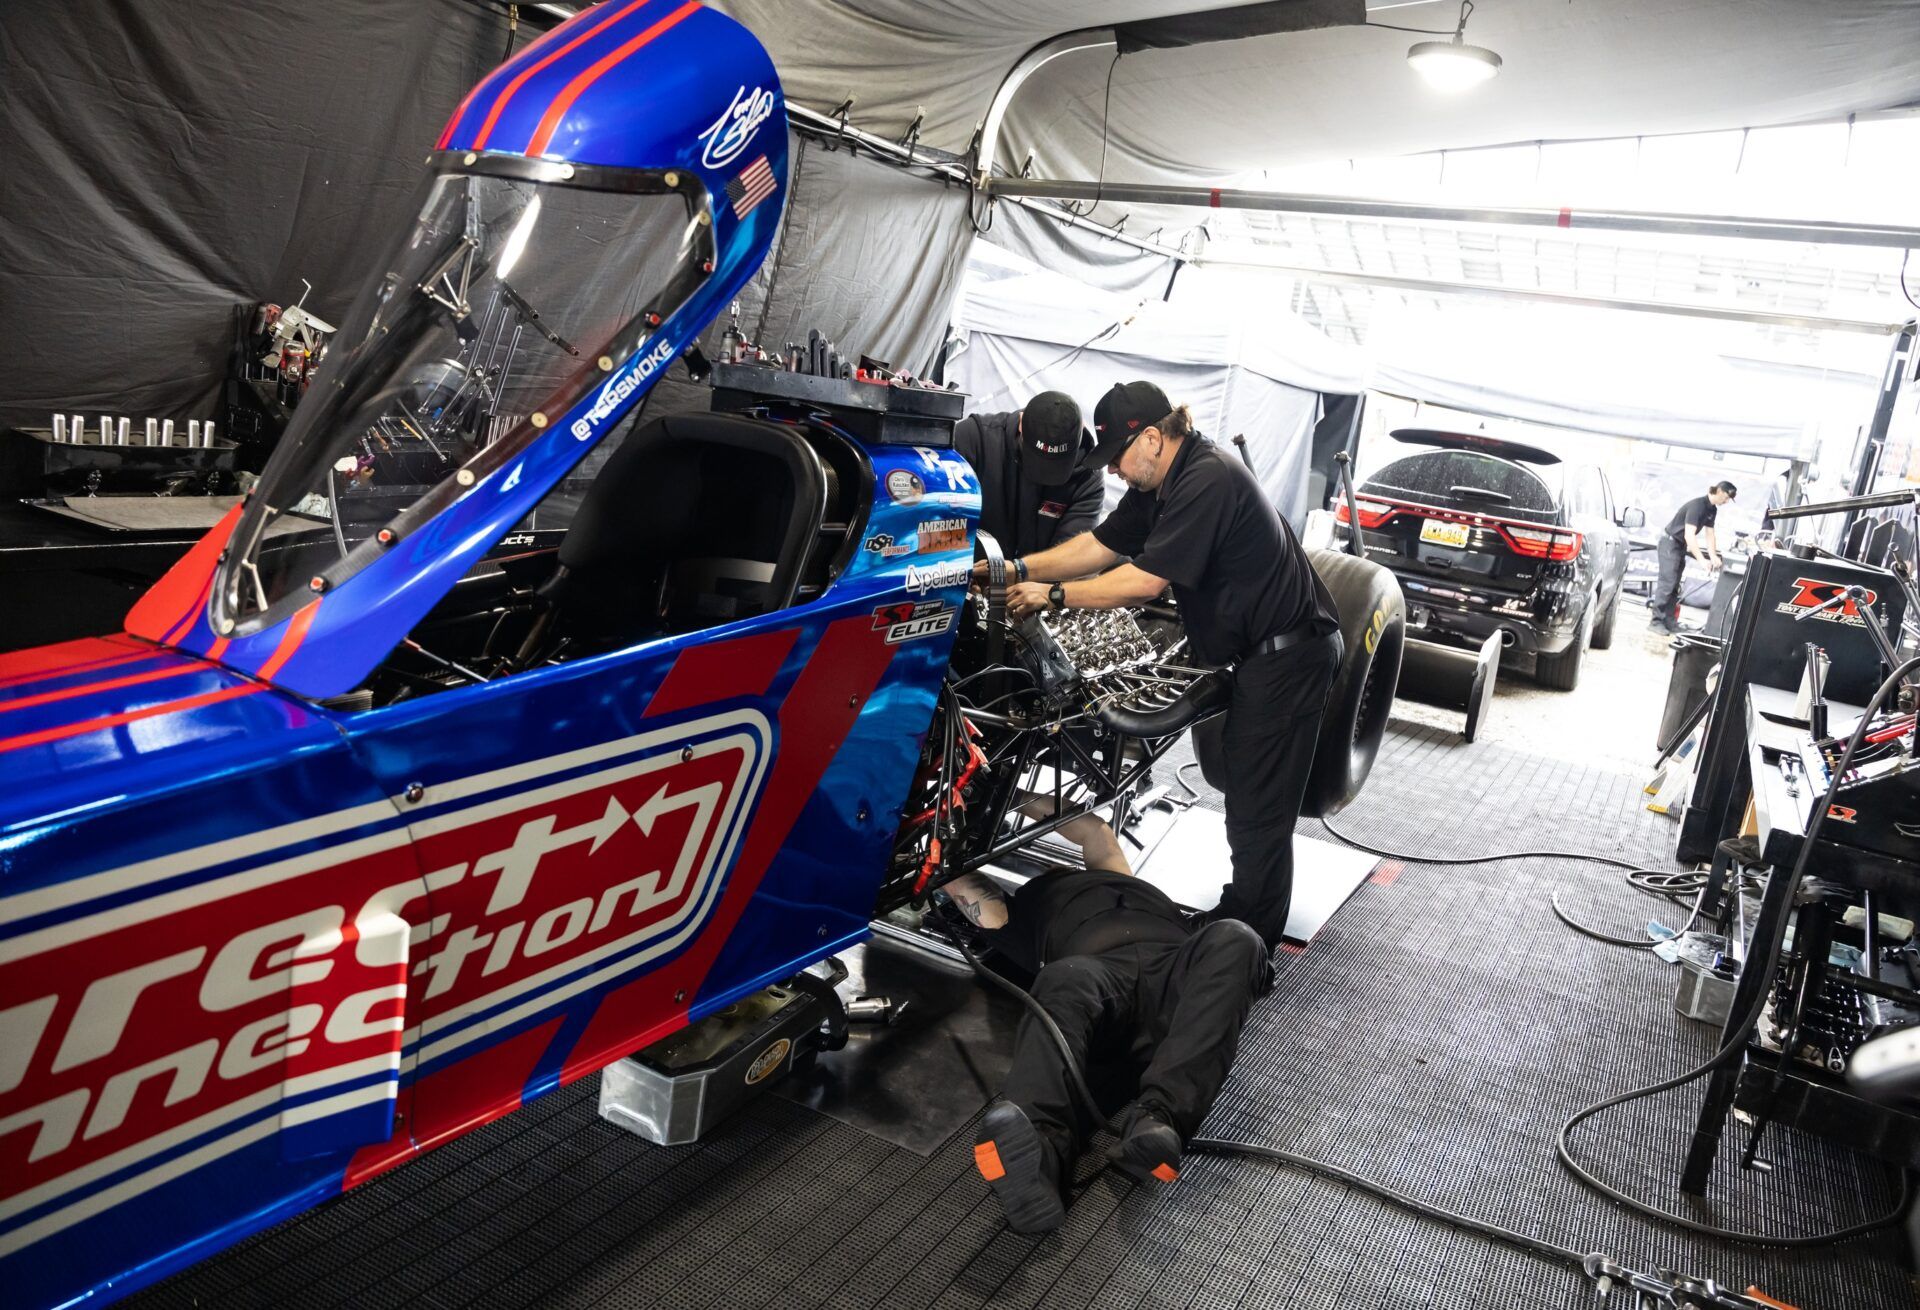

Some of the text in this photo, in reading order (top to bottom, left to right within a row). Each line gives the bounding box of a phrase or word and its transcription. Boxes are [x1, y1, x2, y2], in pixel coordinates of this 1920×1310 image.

[1035, 440, 1059, 454] Mobil
[917, 519, 968, 534] AMERICAN
[864, 534, 894, 552] DSR
[1490, 606, 1535, 618] STEWART
[891, 617, 947, 638] ELITE
